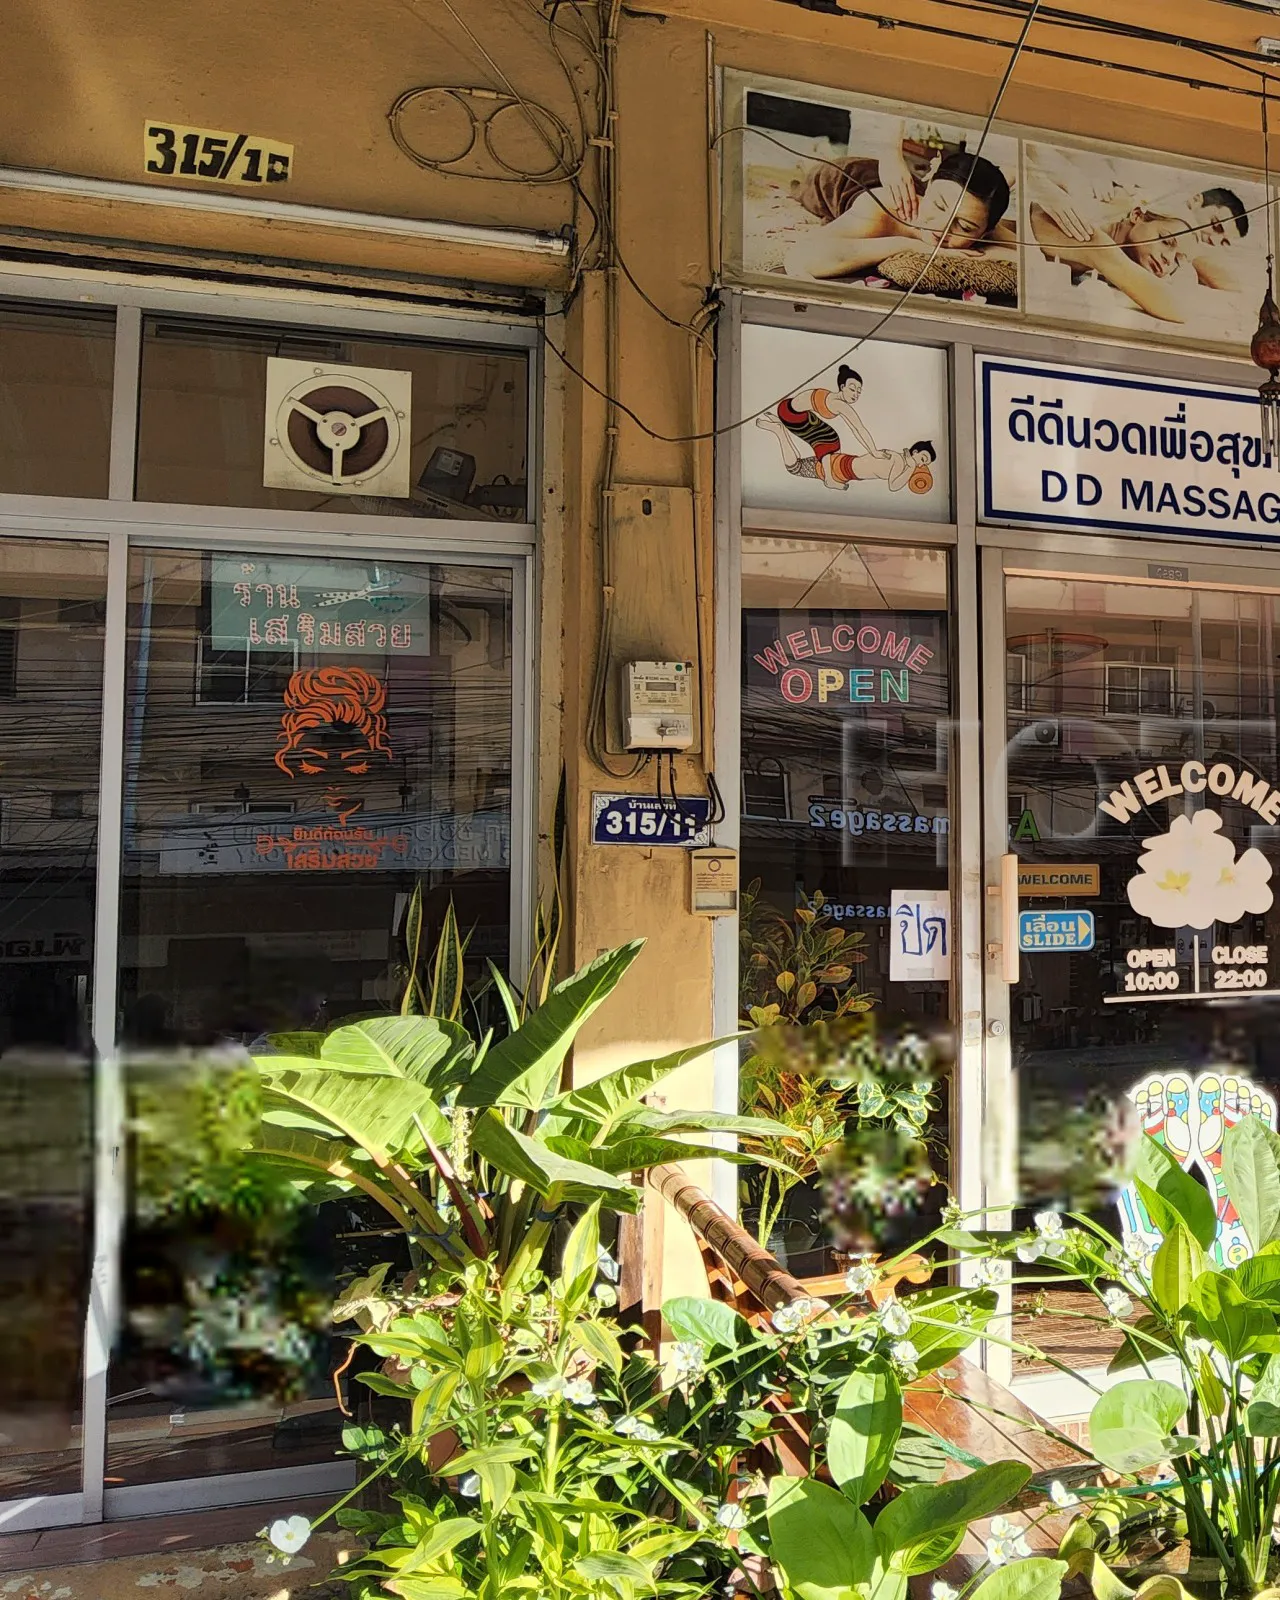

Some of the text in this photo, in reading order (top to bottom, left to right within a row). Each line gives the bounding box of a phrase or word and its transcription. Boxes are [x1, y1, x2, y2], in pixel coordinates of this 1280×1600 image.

[233, 563, 300, 608] ร้าน
[250, 613, 411, 648] เสริมสวย
[753, 624, 935, 675] WELCOME
[780, 667, 911, 703] OPEN
[1018, 873, 1093, 885] WELCOME
[895, 904, 947, 956] ปิด
[1025, 914, 1076, 933] เลื่อน
[1023, 933, 1076, 946] SLIDE
[1126, 945, 1268, 968] OPEN CLOSE
[1124, 968, 1268, 991] 10:00 22:00
